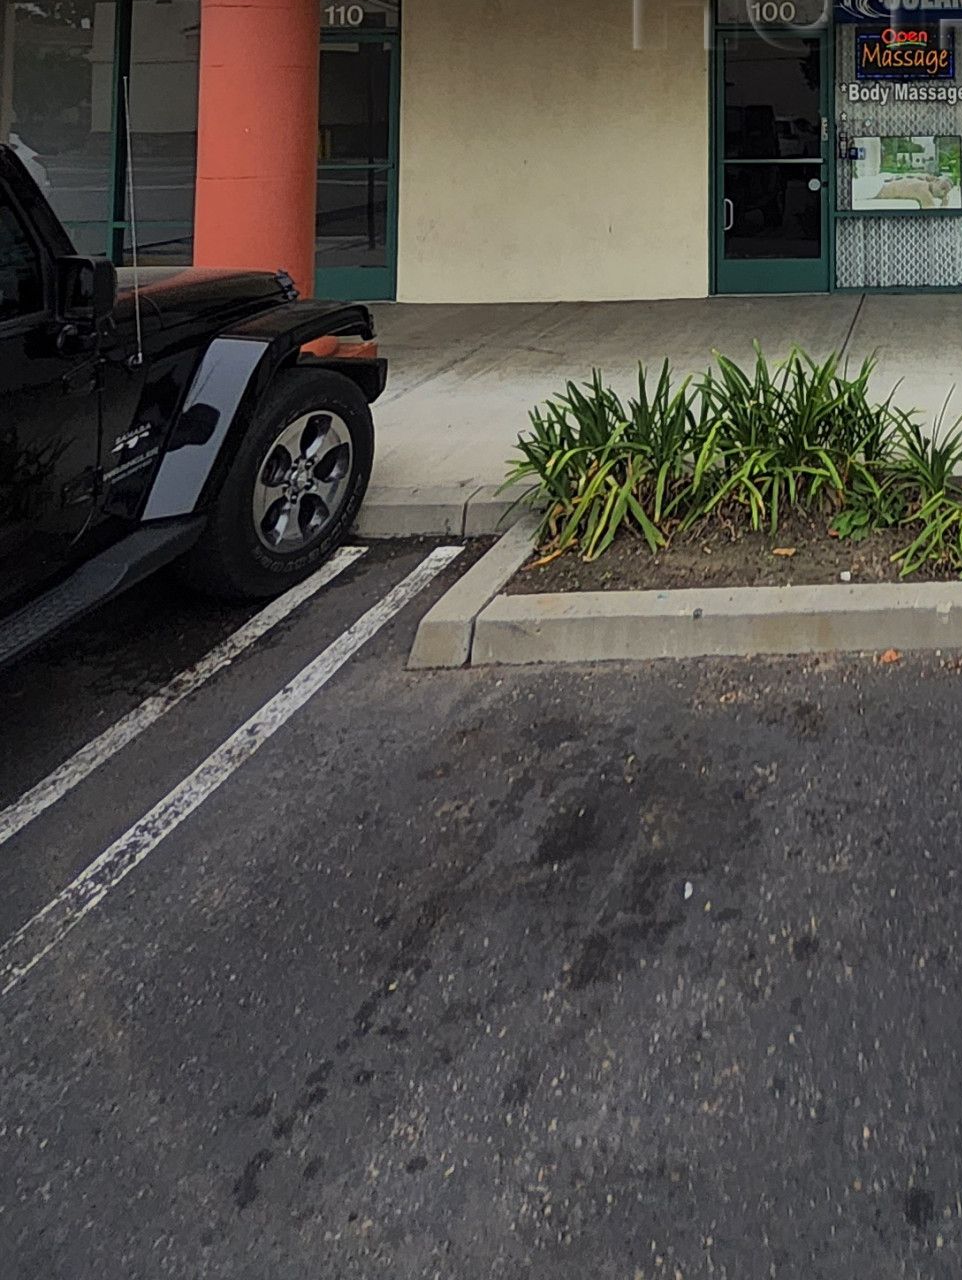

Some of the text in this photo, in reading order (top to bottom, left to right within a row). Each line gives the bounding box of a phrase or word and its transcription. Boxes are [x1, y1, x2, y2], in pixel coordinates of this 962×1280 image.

[324, 5, 364, 25] 110
[751, 1, 796, 22] 100
[881, 28, 928, 45] Open
[861, 42, 949, 74] Massage
[848, 82, 889, 106] Body
